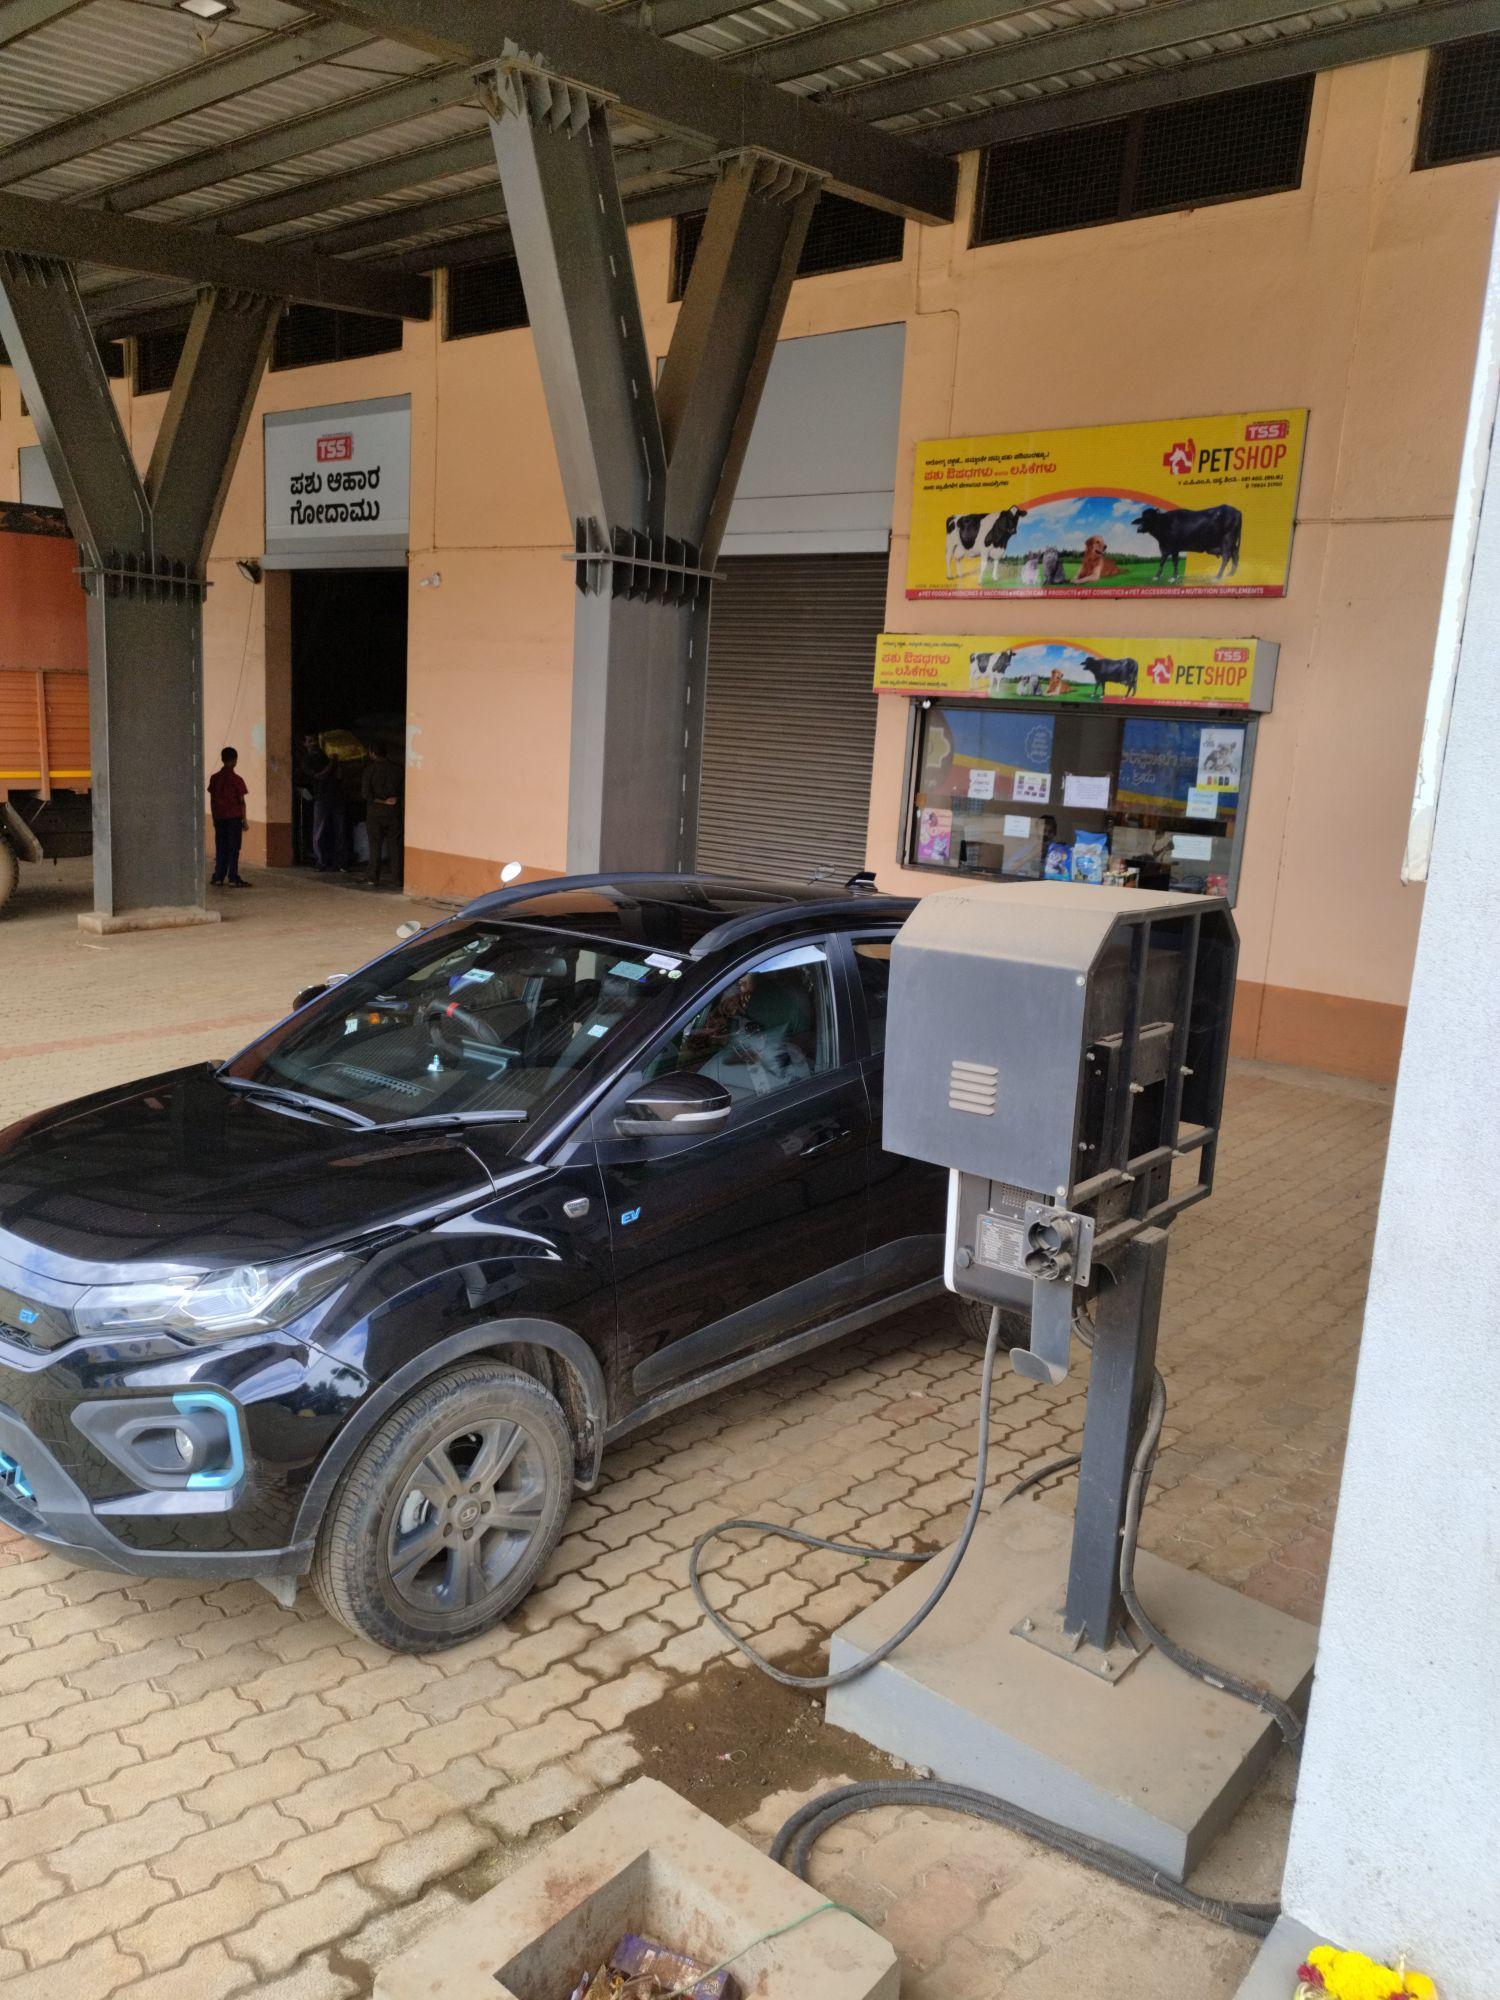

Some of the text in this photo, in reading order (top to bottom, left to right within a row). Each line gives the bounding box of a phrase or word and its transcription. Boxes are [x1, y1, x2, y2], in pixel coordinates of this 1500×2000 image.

[1248, 424, 1280, 439] TSS
[318, 440, 346, 459] TSS
[290, 465, 381, 495] ಪಶು ಆಹಾರ
[290, 498, 380, 525] ಗೋದಾಮು
[1215, 650, 1242, 662] TSS
[621, 1207, 641, 1225] EV
[19, 1308, 38, 1324] EV
